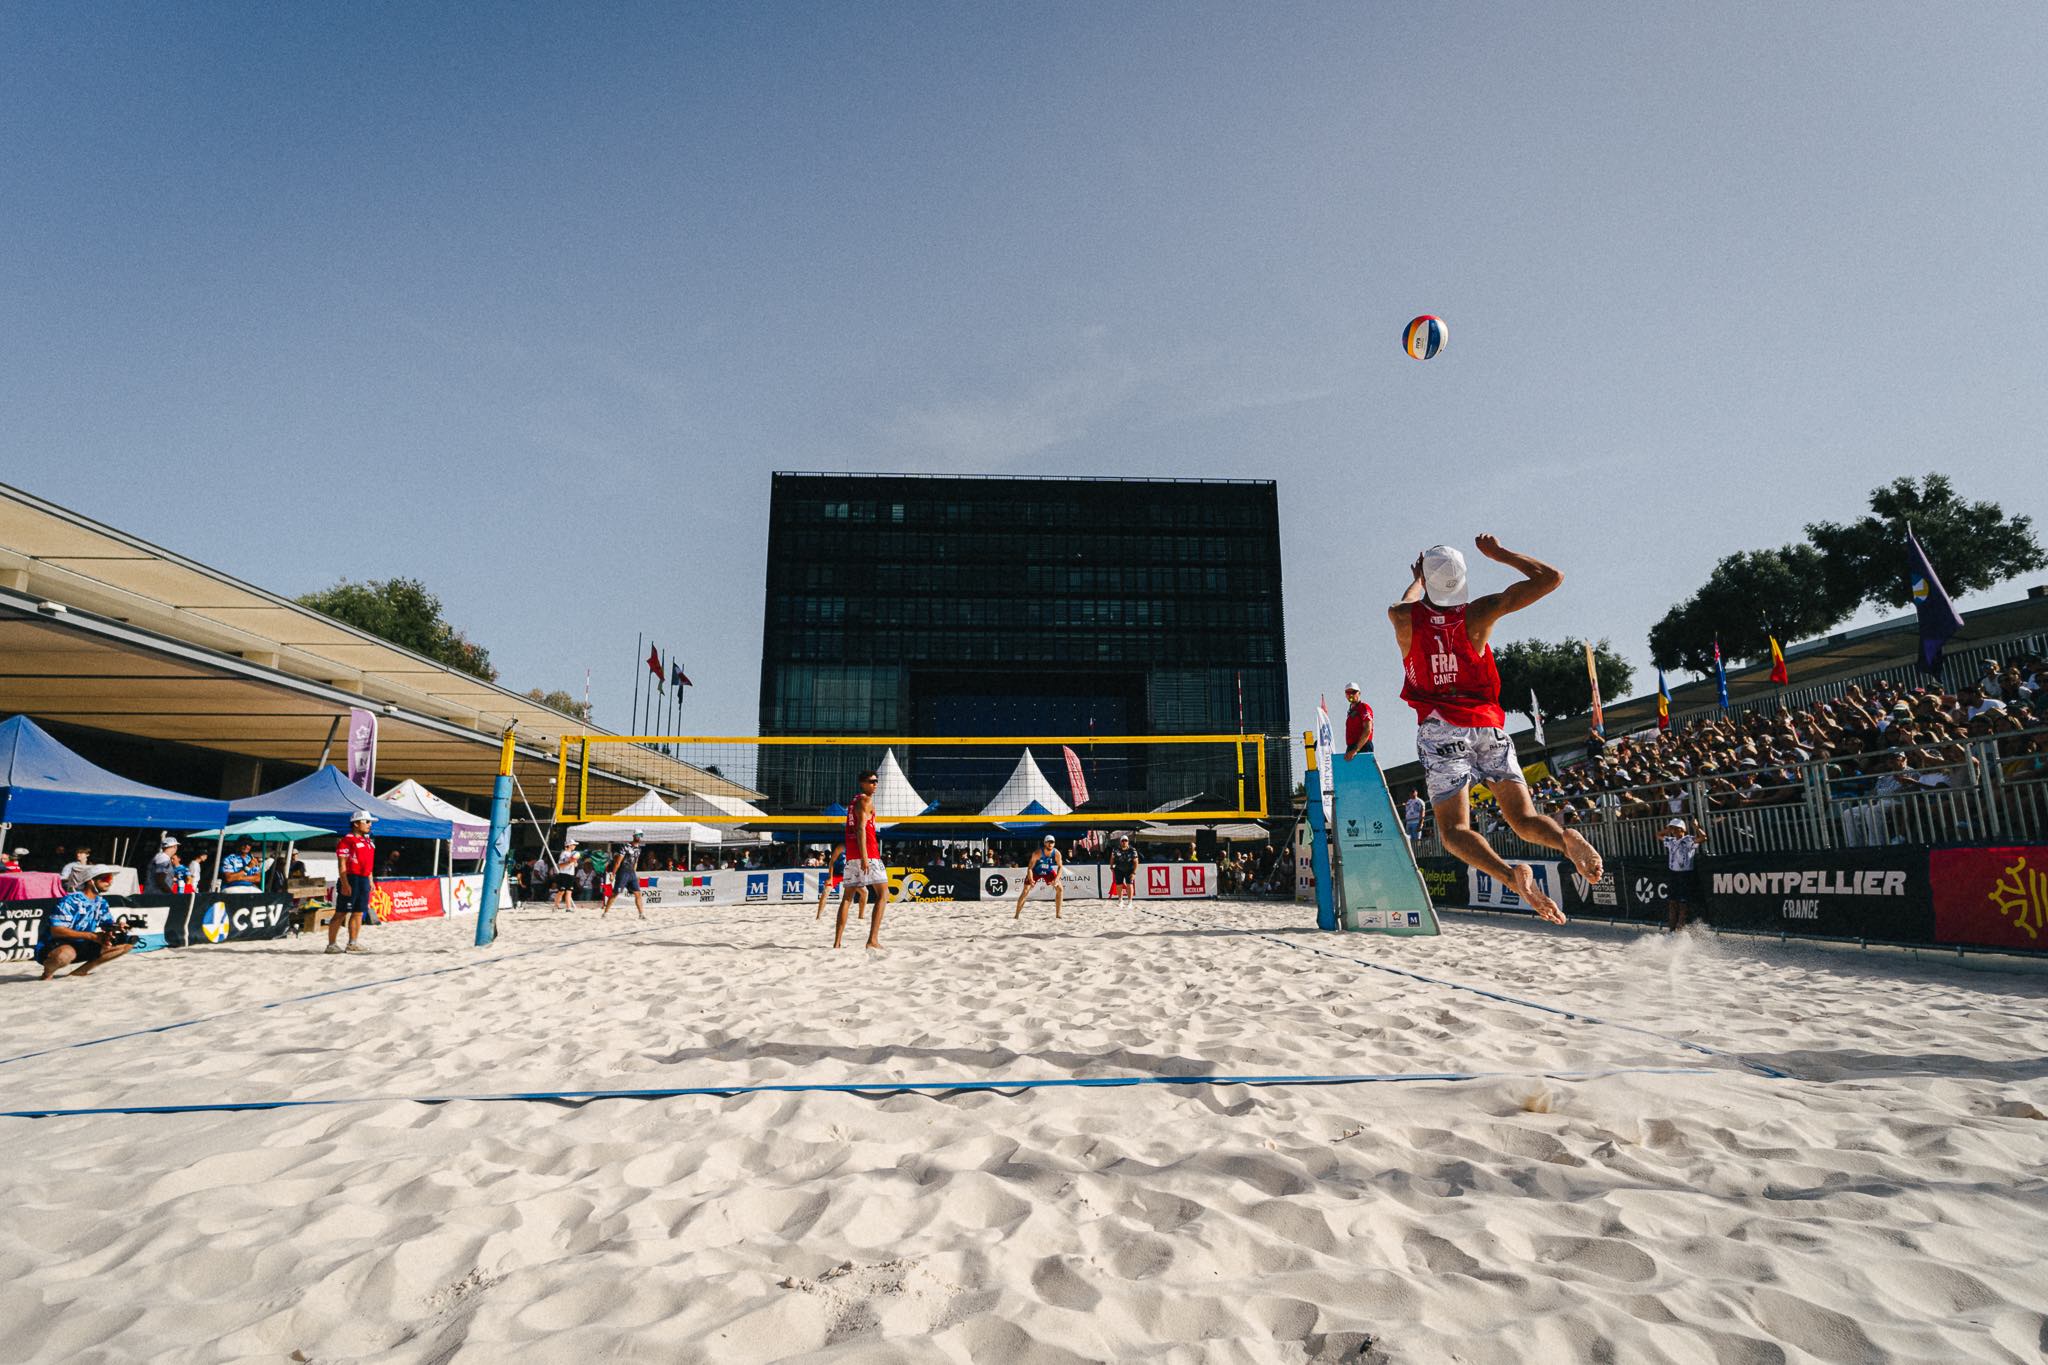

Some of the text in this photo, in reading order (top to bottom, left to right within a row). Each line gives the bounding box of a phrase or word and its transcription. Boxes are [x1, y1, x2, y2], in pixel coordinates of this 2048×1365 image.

[1431, 653, 1458, 673] FRA
[1434, 673, 1457, 685] CANET
[750, 882, 764, 894] M
[786, 880, 800, 892] M
[928, 884, 955, 895] CEV
[1713, 871, 1907, 896] MONTPELLIER
[691, 889, 716, 897] SPORT
[6, 908, 44, 919] WORLD
[1783, 899, 1820, 919] FRANCE
[232, 903, 284, 932] CEV
